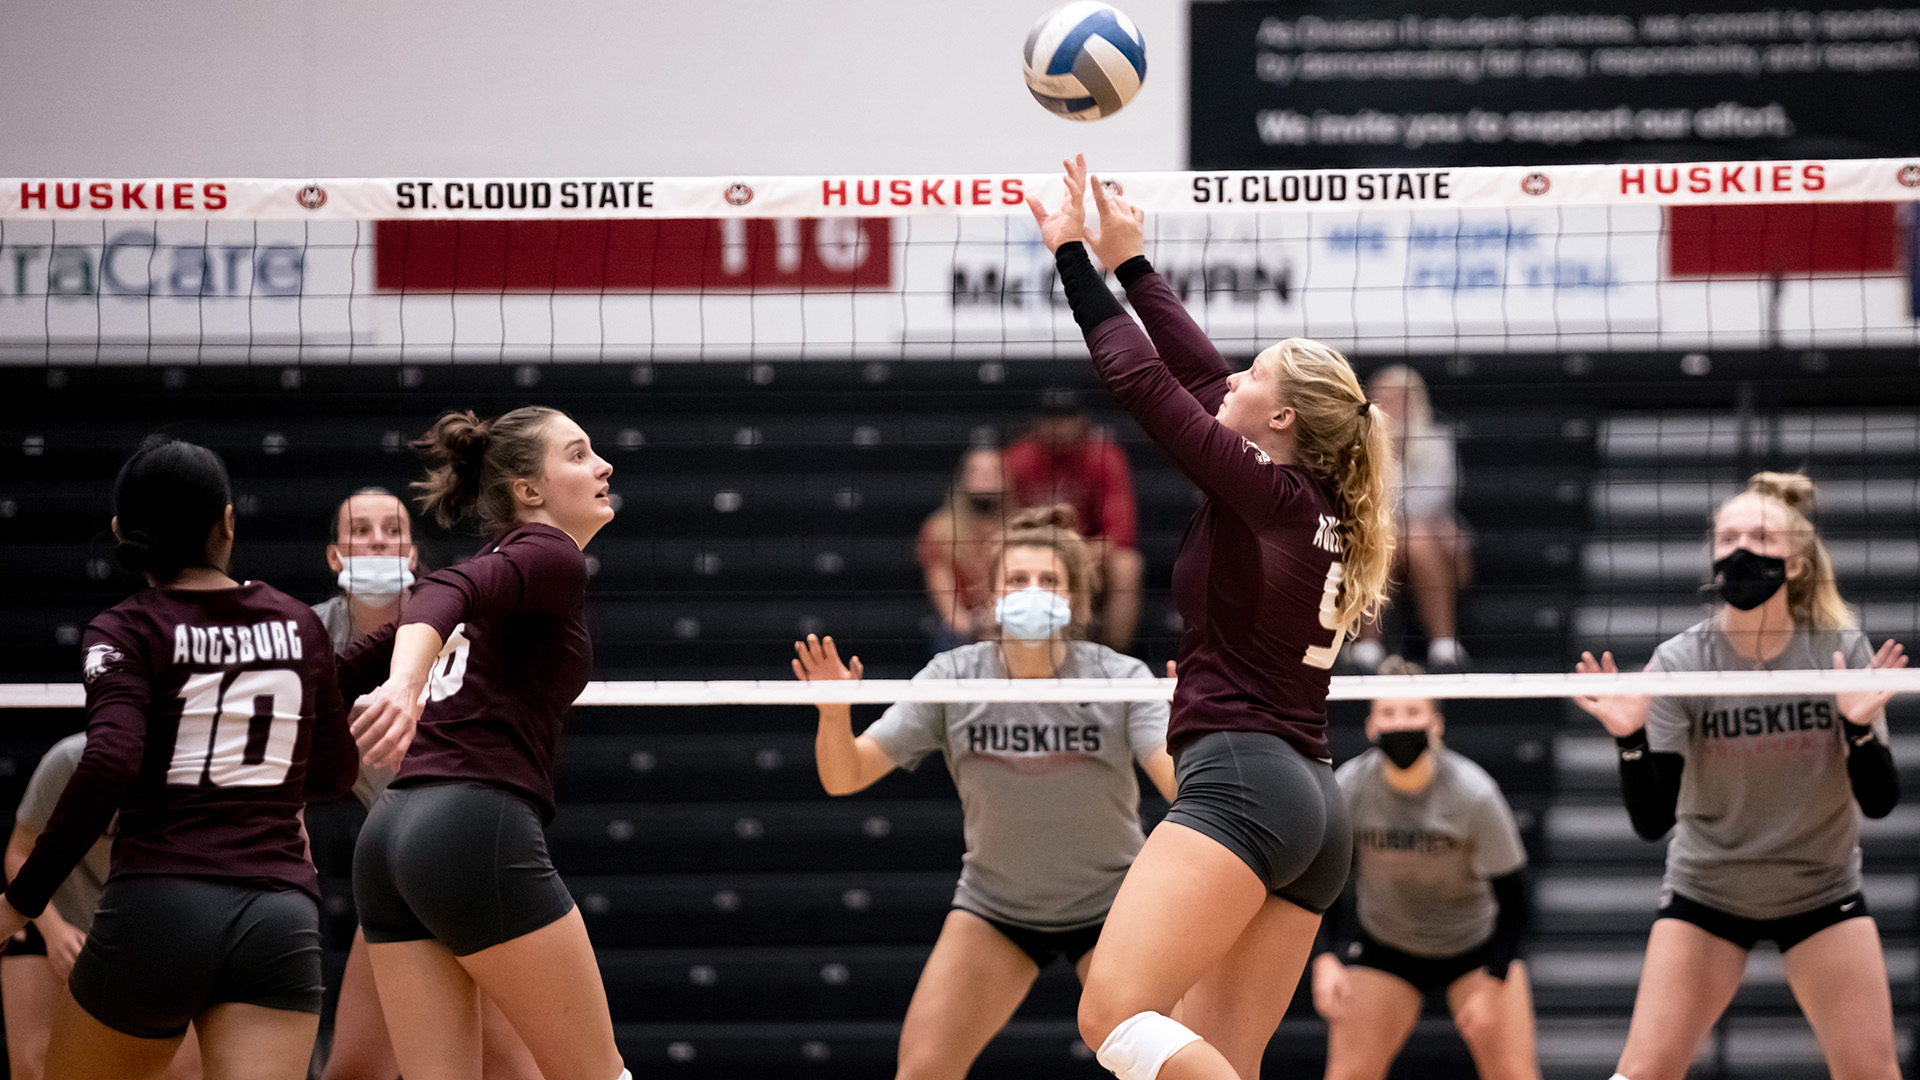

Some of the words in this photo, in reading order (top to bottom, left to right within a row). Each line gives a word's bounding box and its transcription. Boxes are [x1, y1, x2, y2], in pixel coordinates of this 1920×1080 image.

[1259, 113, 1313, 141] We
[1315, 112, 1402, 141] invite
[1404, 115, 1467, 145] you
[1467, 110, 1507, 139] to
[1506, 109, 1633, 142] support
[1636, 111, 1693, 136] our
[396, 182, 438, 209] ST.
[444, 182, 552, 209] CLOUD
[560, 181, 654, 208] STATE
[822, 179, 1025, 206] HUSKIES
[1193, 174, 1233, 204] ST.
[1241, 172, 1347, 204] CLOUD
[1356, 171, 1451, 202] STATE
[1621, 164, 1826, 195] HUSKIES
[20, 183, 228, 210] HUSKIES
[0, 229, 306, 304] raCare
[173, 620, 303, 665] AUGSBURG
[166, 669, 303, 788] 10
[1703, 701, 1834, 739] HUSKIES
[968, 723, 1101, 752] HUSKIES
